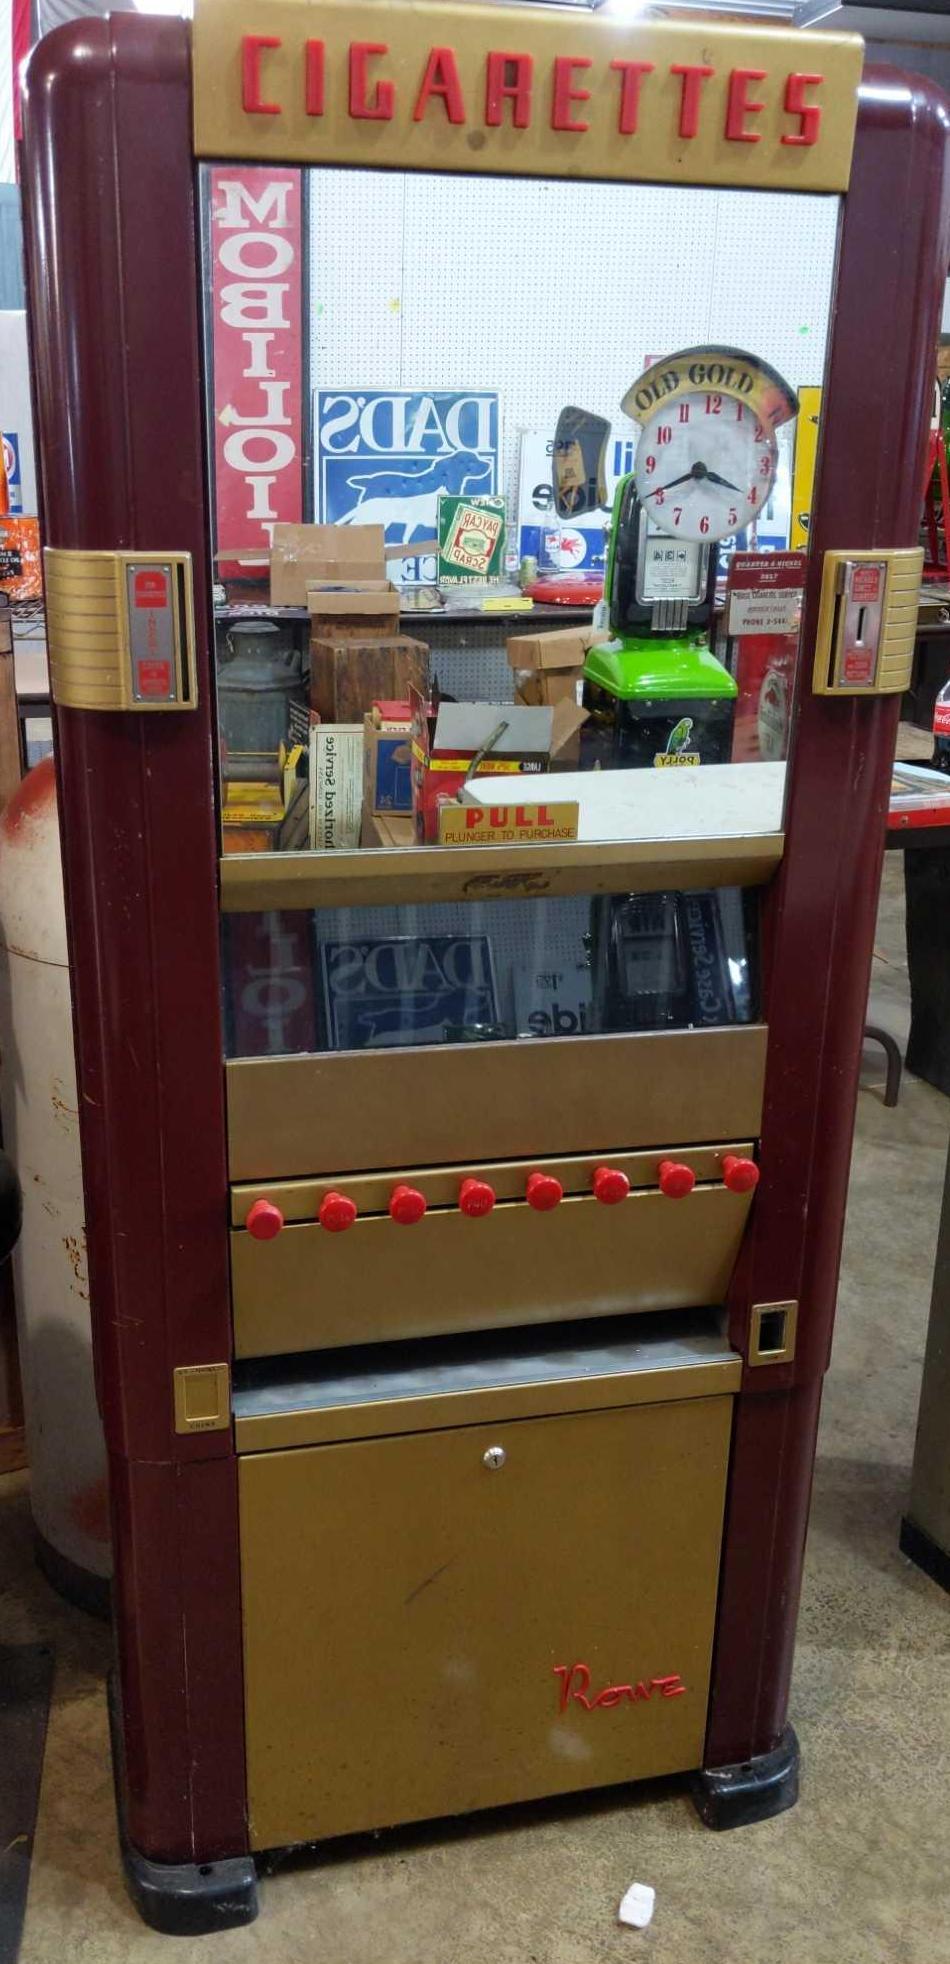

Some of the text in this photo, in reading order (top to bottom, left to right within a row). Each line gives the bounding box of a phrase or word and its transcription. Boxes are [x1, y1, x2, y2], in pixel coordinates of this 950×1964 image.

[241, 35, 824, 145] CIGARETTES
[635, 363, 754, 411] OLD GOLD
[679, 404, 690, 423] 11
[705, 395, 722, 414] 12
[736, 400, 745, 421] 1
[656, 426, 672, 445] 10
[754, 426, 763, 443] 2
[646, 456, 656, 474] 9
[760, 456, 770, 475] 3
[747, 486, 757, 504] 4
[673, 507, 683, 525] 7
[700, 517, 709, 534] 6
[728, 508, 737, 525] 5
[466, 805, 555, 829] PULL
[445, 827, 576, 843] PLUNGER TO PURCHASE
[553, 1662, 687, 1714] Rowe
